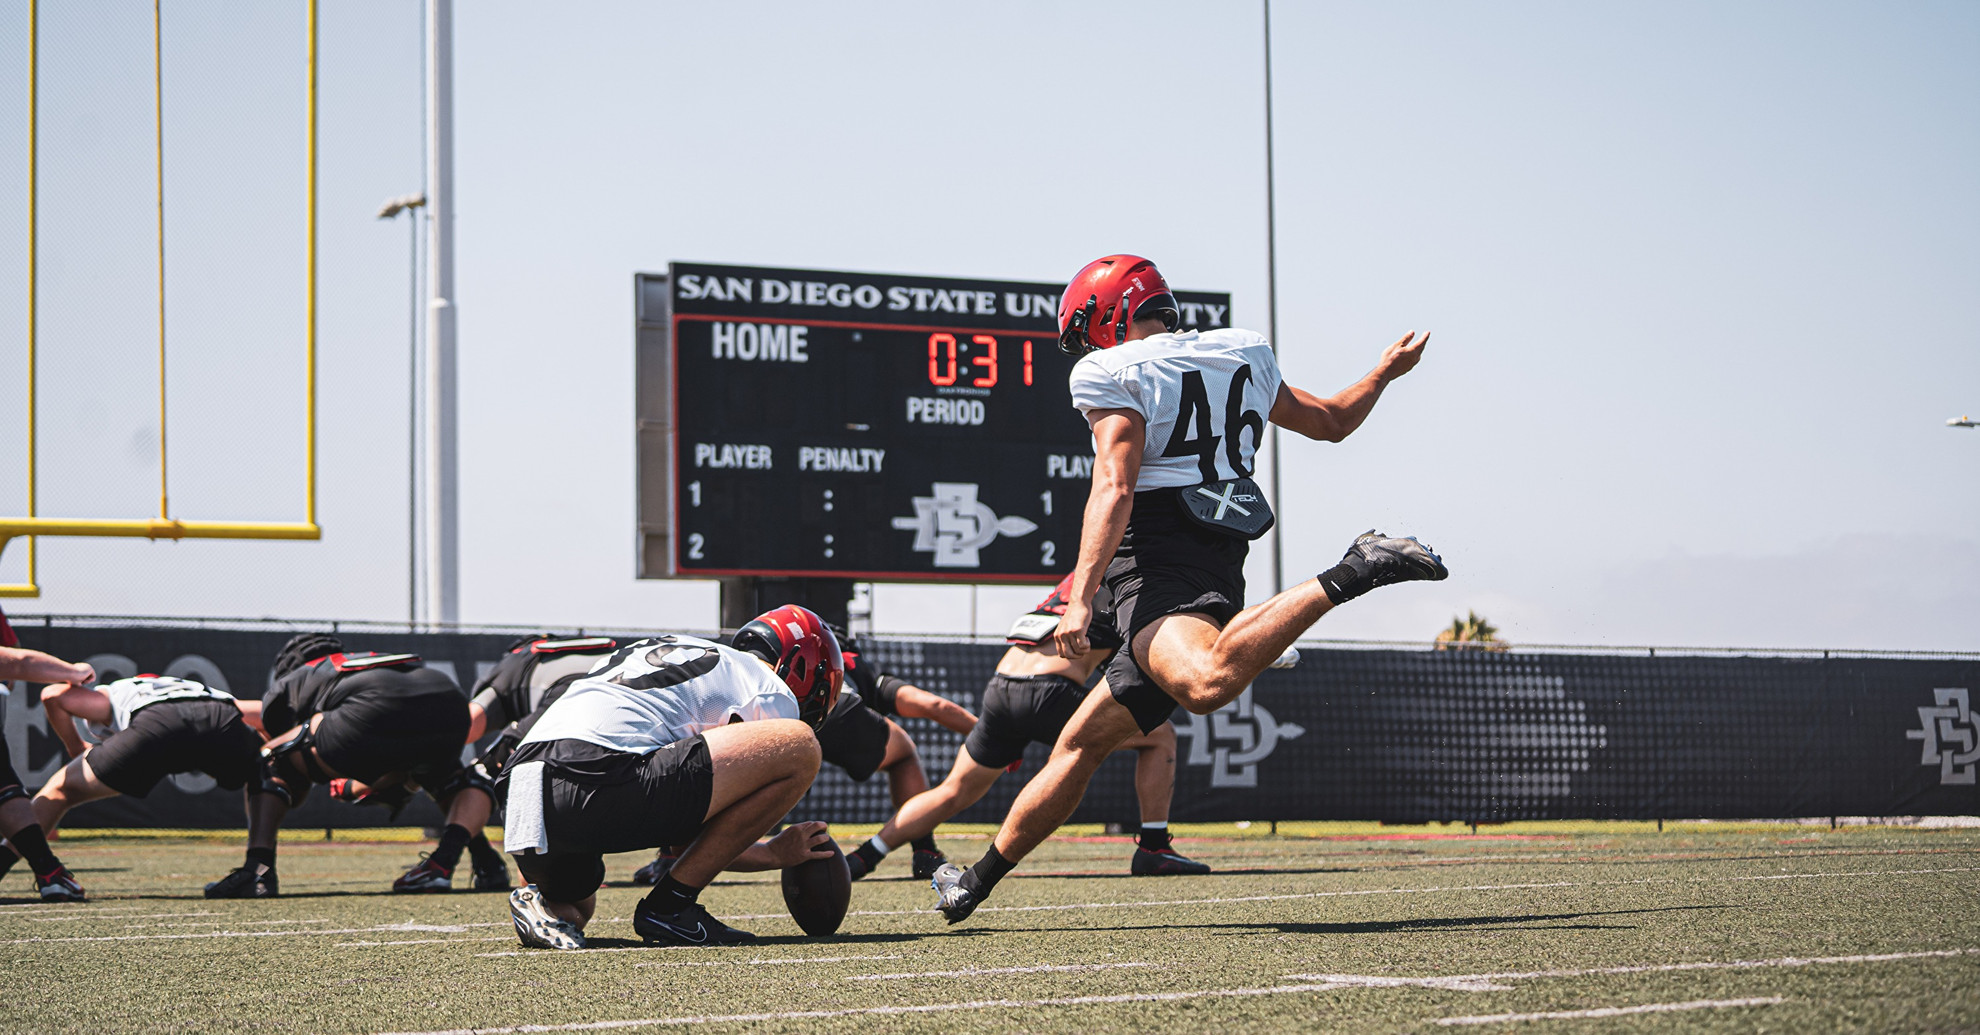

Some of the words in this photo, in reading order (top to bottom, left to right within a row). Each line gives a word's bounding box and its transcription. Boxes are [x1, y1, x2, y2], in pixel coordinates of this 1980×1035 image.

[677, 274, 754, 303] SAN
[760, 278, 883, 309] DIEGO
[887, 286, 997, 315] STATE
[712, 321, 809, 363] HOME
[906, 396, 985, 426] PERIOD
[1161, 363, 1263, 482] 46
[694, 443, 773, 470] PLAYER
[799, 446, 885, 473] PENALTY
[1047, 454, 1095, 479] PLAY
[687, 480, 701, 507] 1
[1040, 490, 1053, 516] 1
[687, 532, 704, 560] 2
[1040, 540, 1056, 566] 2
